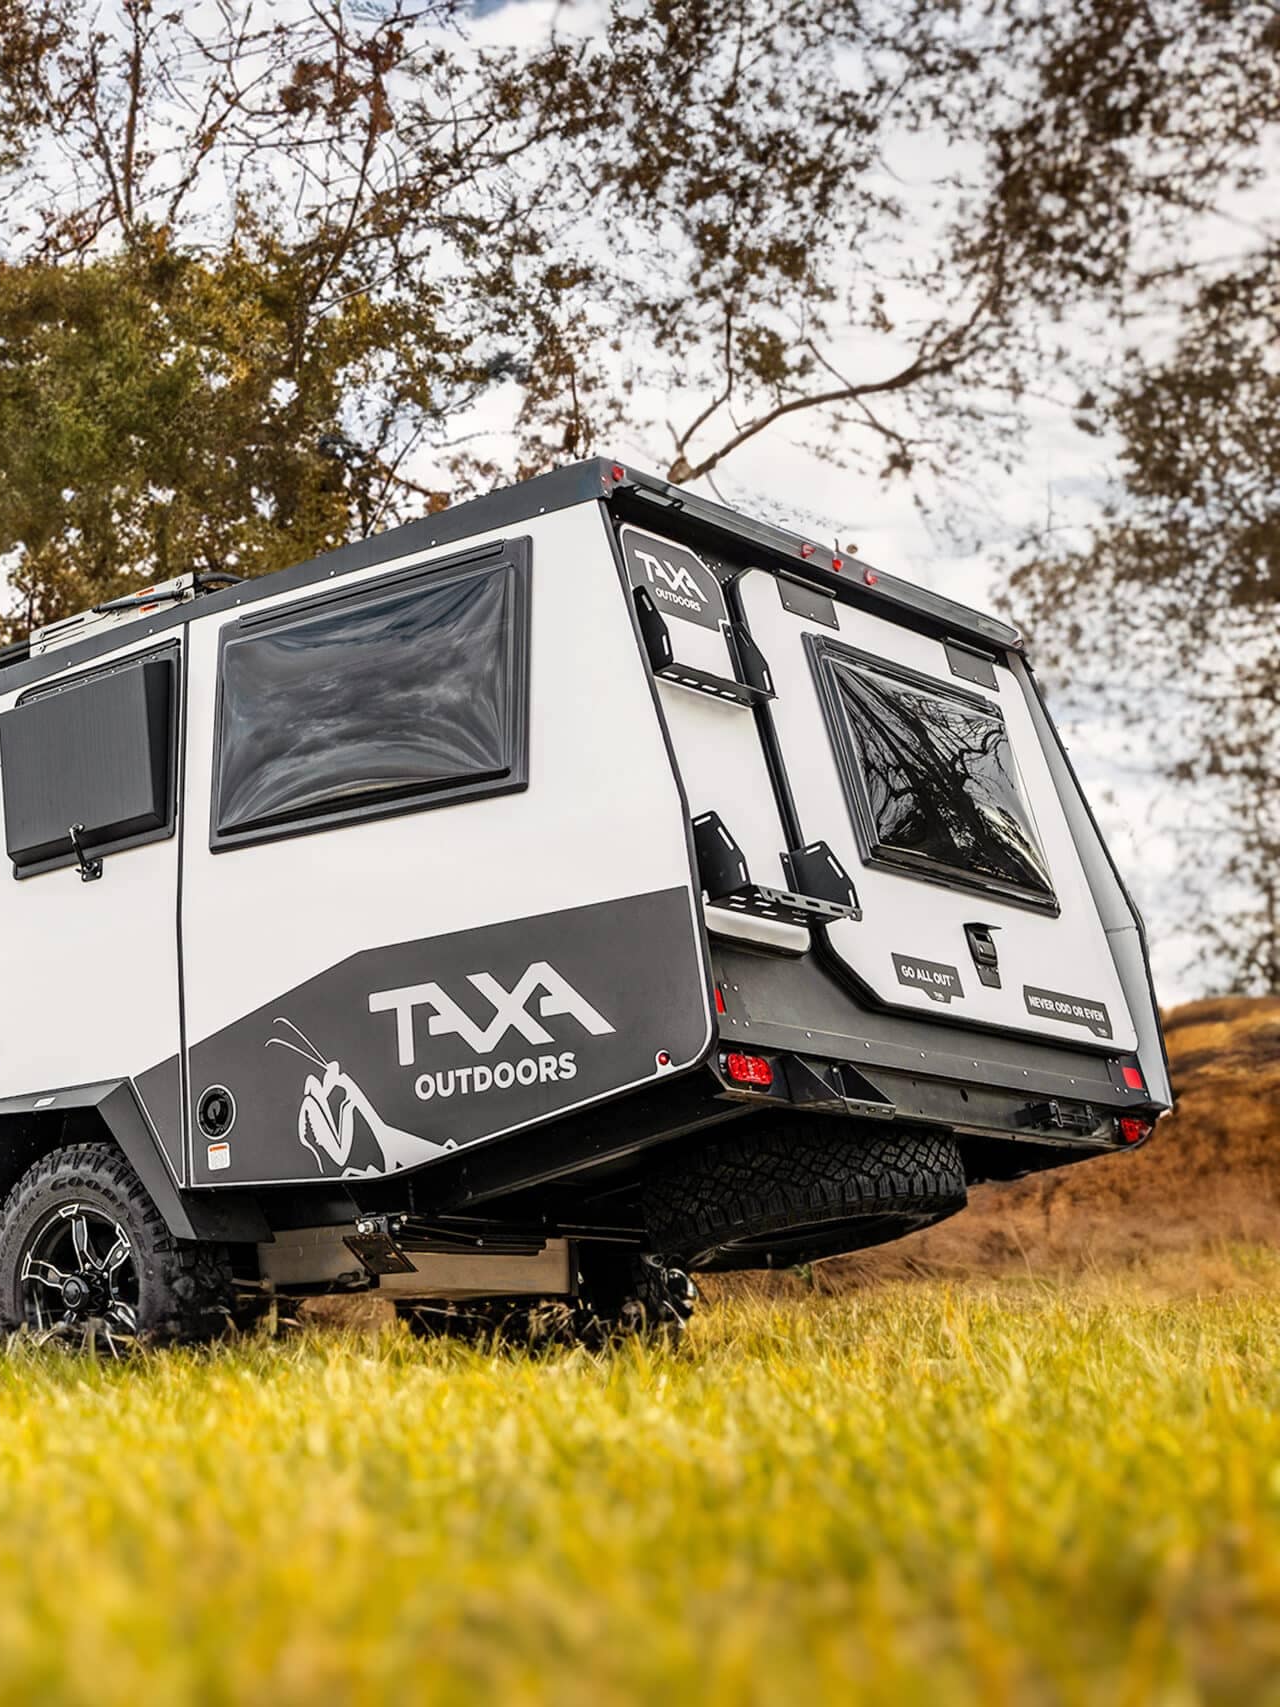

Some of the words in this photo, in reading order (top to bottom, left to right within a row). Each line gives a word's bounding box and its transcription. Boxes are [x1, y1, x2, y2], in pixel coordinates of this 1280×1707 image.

[634, 549, 709, 604] TAXA
[655, 587, 702, 612] OUTDOORS
[901, 965, 915, 978] GO
[916, 968, 933, 983] ALL
[368, 960, 617, 1067] TAXA
[1028, 994, 1055, 1011] NEVER
[1055, 1001, 1072, 1014] ODD
[1072, 1006, 1085, 1018] OR
[1085, 1007, 1105, 1022] EVEN
[414, 1051, 578, 1101] OUTDOORS
